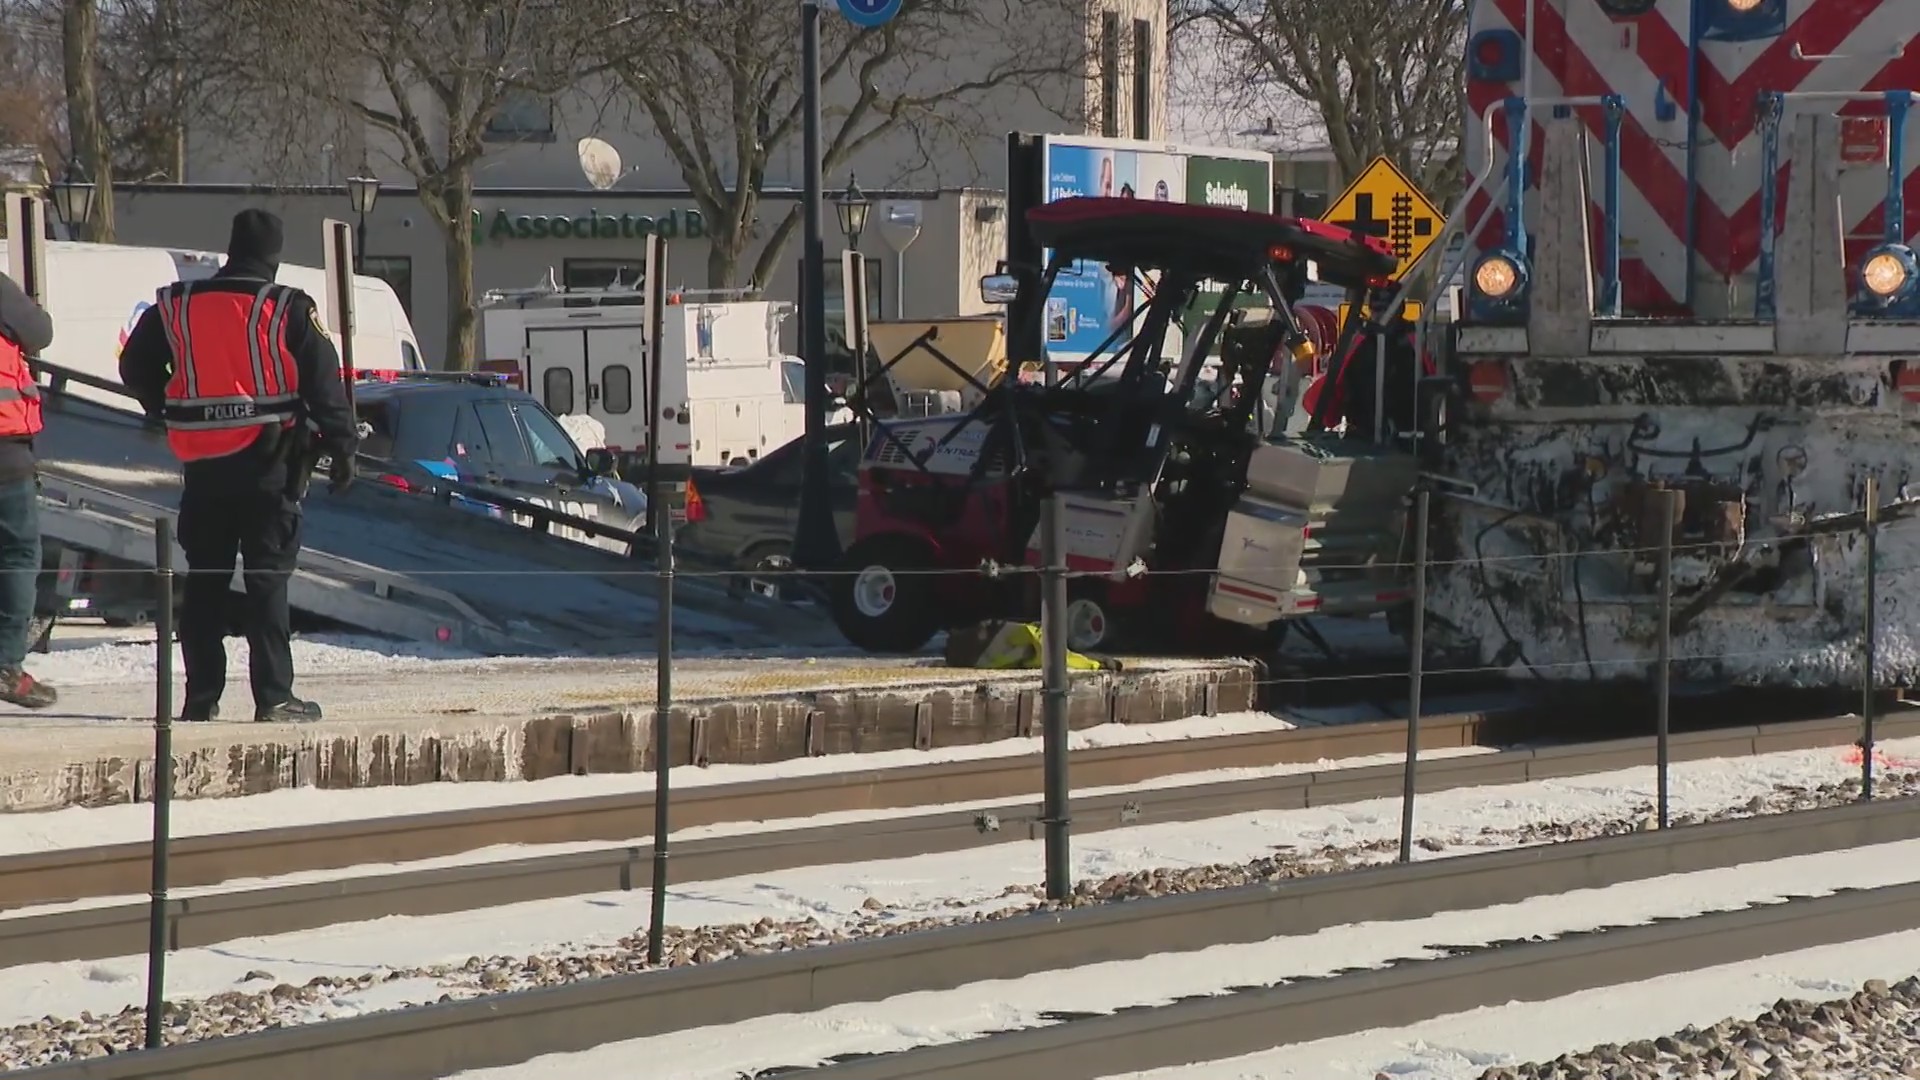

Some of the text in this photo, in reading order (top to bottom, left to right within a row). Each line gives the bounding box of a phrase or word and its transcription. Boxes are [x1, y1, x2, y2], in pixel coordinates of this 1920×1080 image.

[1205, 181, 1248, 212] Selecting
[489, 207, 678, 239] Associated
[204, 403, 256, 420] POLICE
